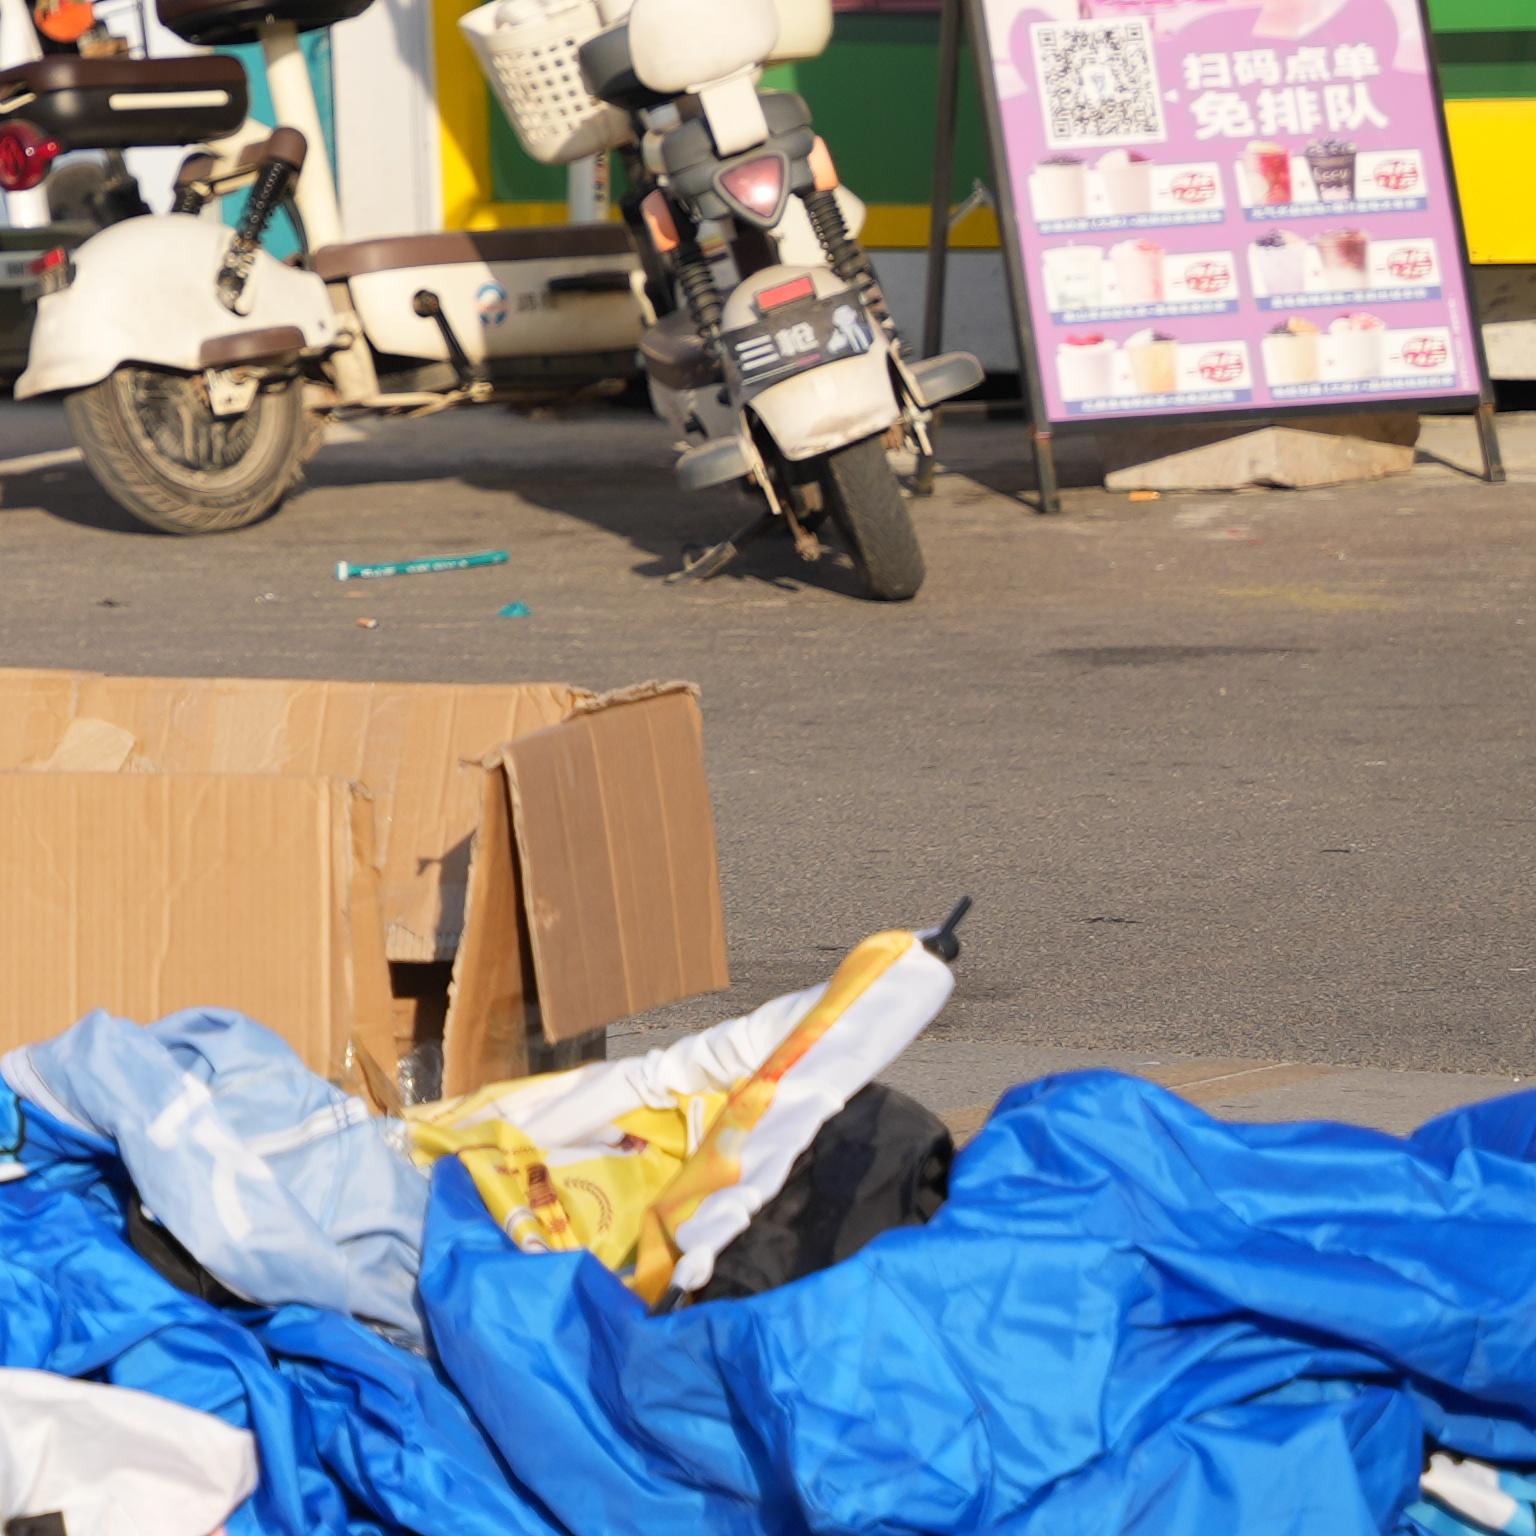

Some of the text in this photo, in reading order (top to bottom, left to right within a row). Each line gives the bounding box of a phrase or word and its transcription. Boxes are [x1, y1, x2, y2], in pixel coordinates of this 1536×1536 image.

[1182, 42, 1383, 90] 扫码点单
[1189, 81, 1391, 141] 免排队
